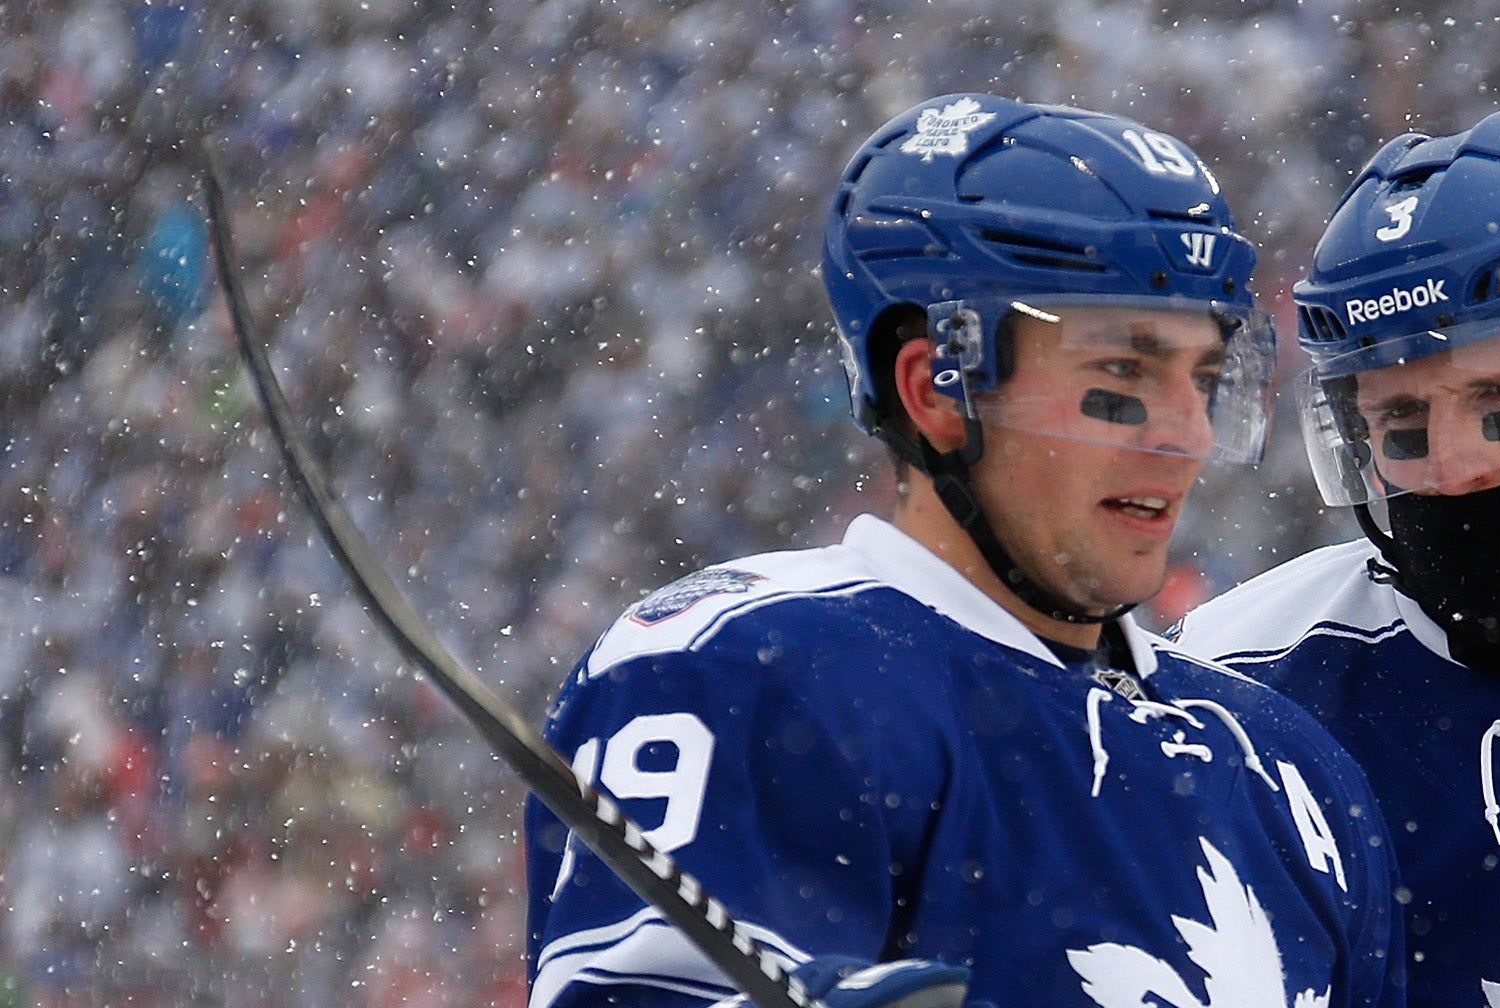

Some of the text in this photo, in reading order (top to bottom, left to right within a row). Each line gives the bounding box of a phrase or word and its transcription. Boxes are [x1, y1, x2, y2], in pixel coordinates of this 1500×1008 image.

[1123, 128, 1195, 178] 19
[1376, 196, 1419, 242] 3
[1345, 278, 1448, 326] Reebok
[1276, 760, 1349, 892] A
